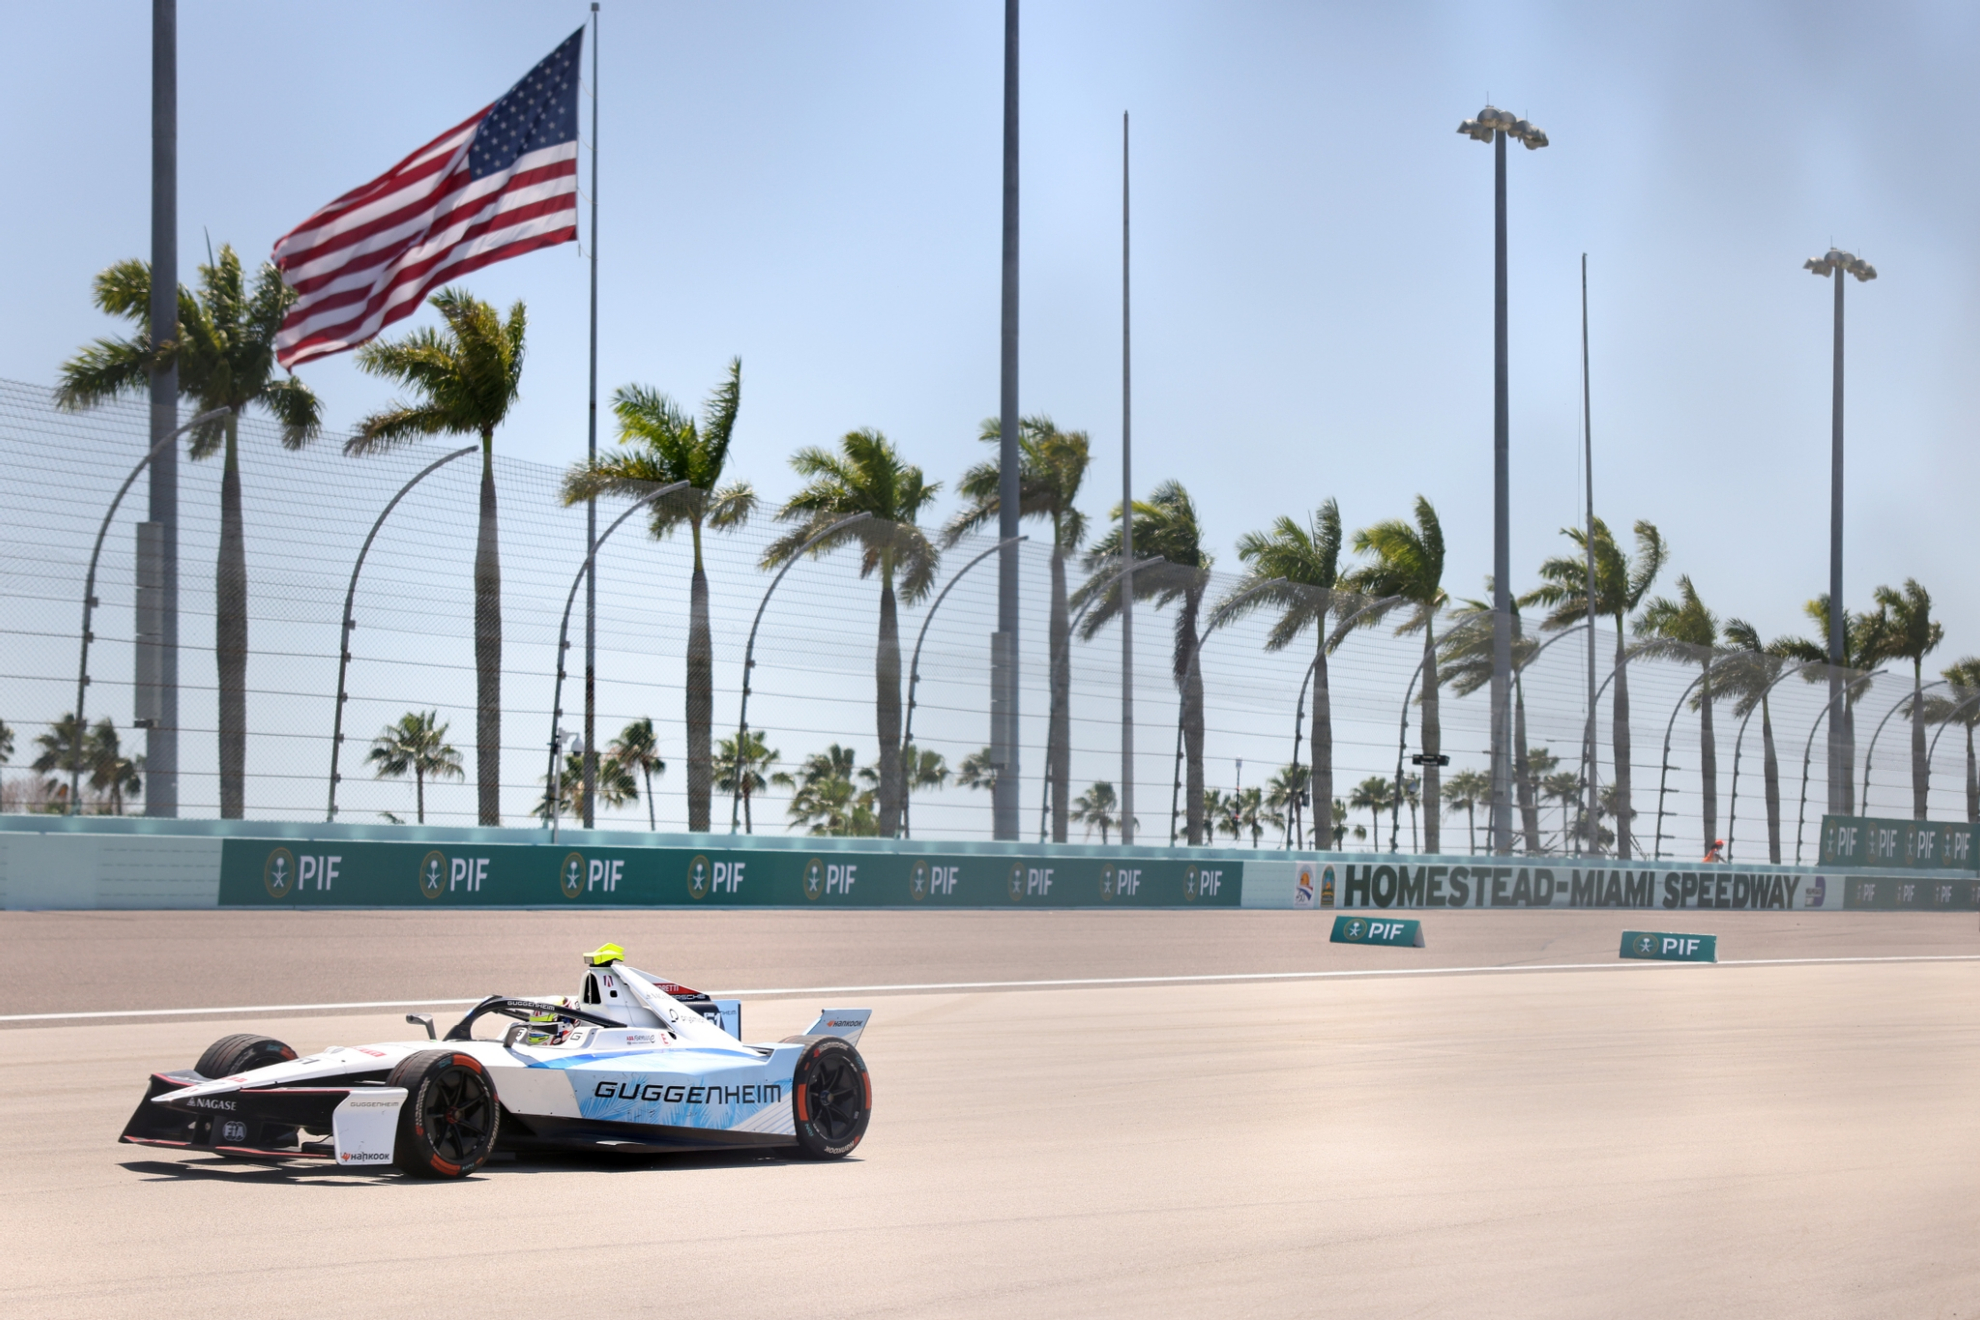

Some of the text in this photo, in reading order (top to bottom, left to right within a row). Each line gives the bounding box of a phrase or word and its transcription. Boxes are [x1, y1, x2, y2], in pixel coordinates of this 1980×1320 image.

[1837, 827, 1858, 856] PIF
[1878, 829, 1898, 857] PIF
[1917, 831, 1936, 859] PIF
[1954, 832, 1971, 860] PIF
[299, 856, 342, 891] PIF
[450, 858, 490, 892] PIF
[588, 860, 625, 892] PIF
[711, 862, 746, 893] PIF
[825, 864, 857, 894] PIF
[930, 866, 959, 894] PIF
[1026, 868, 1054, 896] PIF
[1117, 869, 1141, 896] PIF
[1200, 870, 1223, 896] PIF
[1344, 864, 1656, 909] HOMESTEAD-MIAMI
[1662, 871, 1801, 909] SPEEDWAY
[1863, 884, 1876, 901] PIF
[1903, 884, 1915, 903] PIF
[1941, 886, 1952, 903] PIF
[1368, 922, 1405, 940] PIF
[1662, 937, 1701, 956] PIF
[507, 1000, 555, 1011] GUGGENHEIM
[196, 1098, 237, 1111] NAGASE
[594, 1081, 782, 1105] GUGGENHEIM
